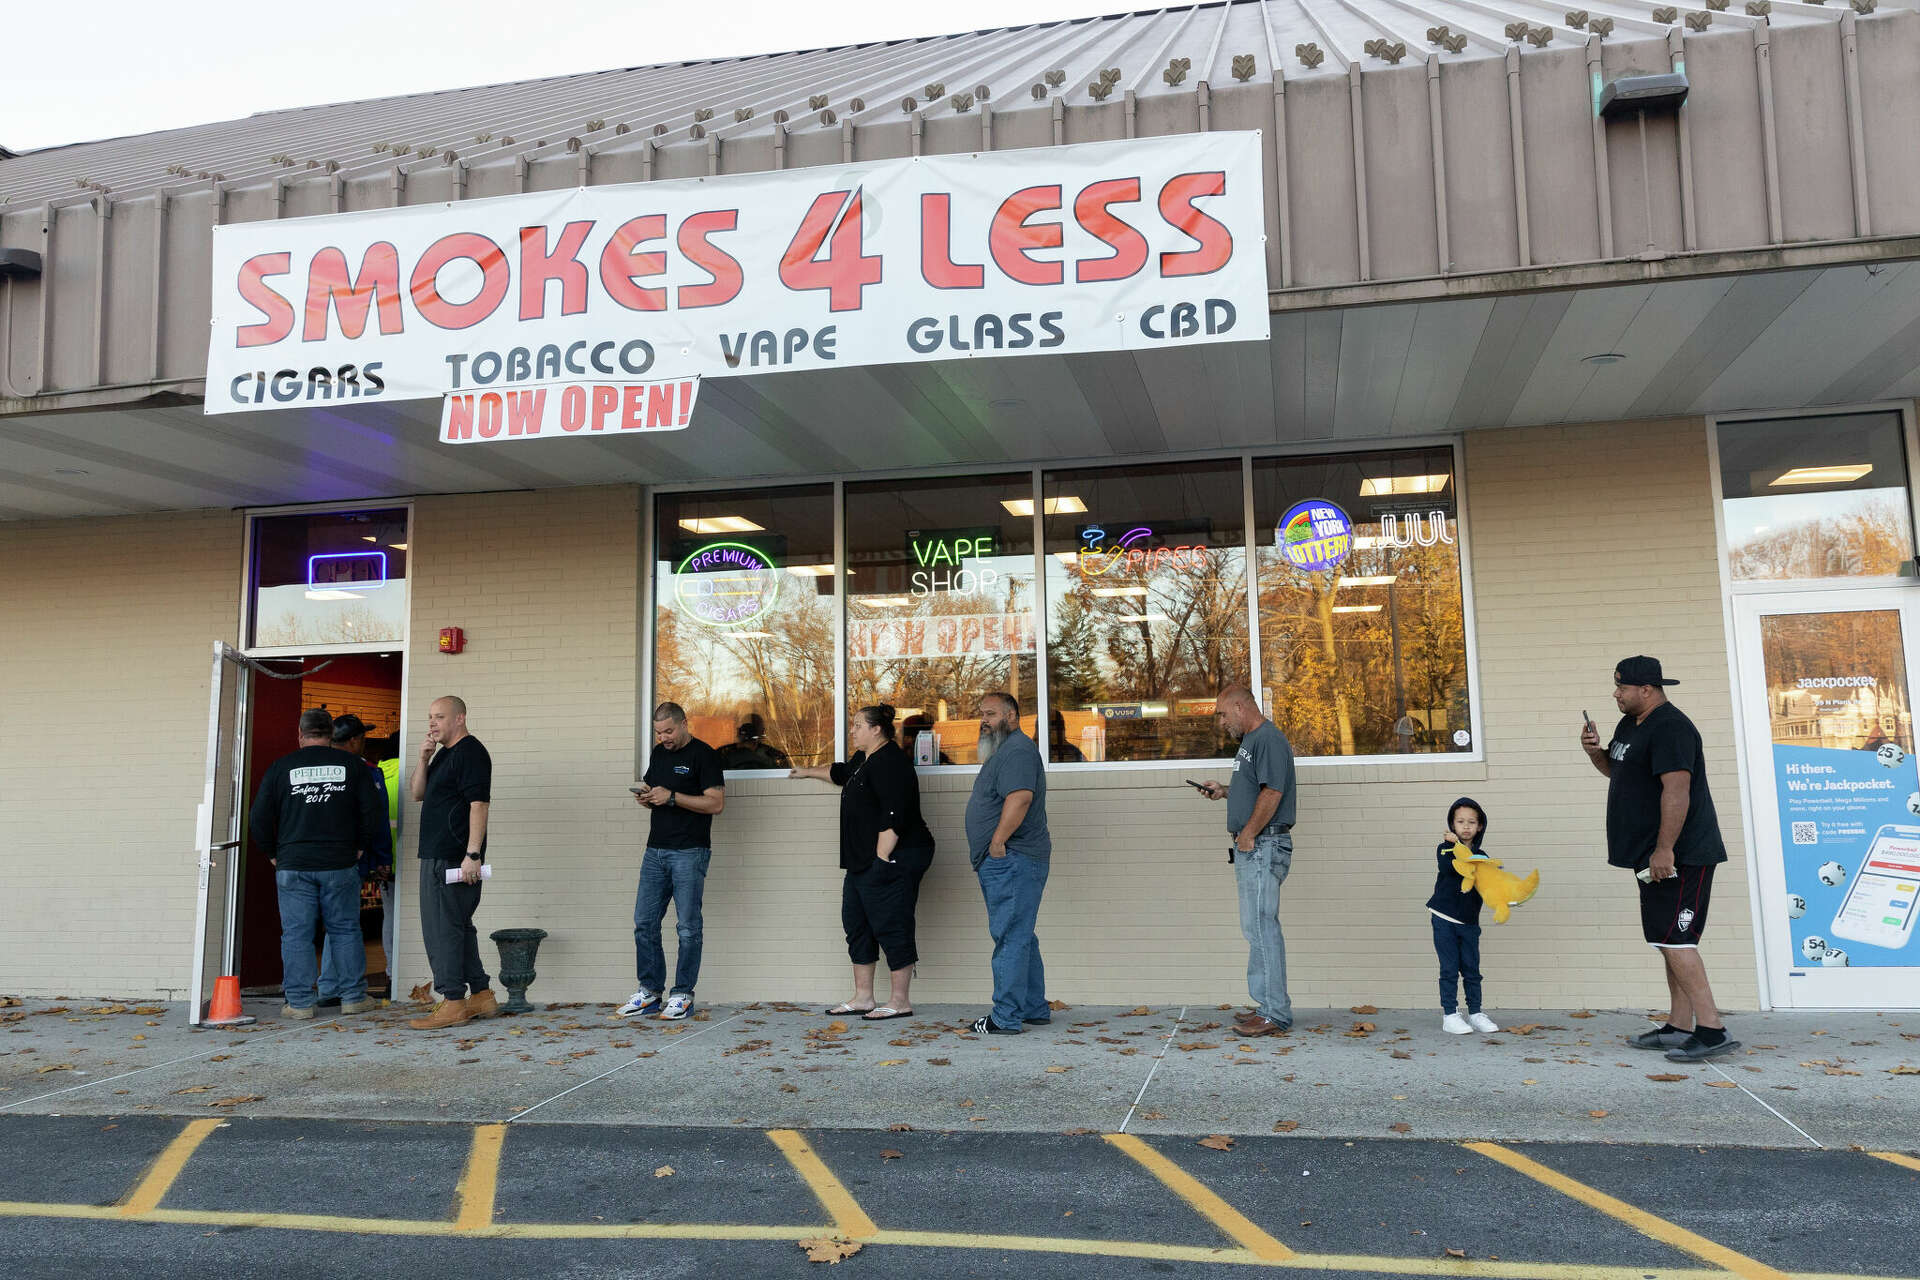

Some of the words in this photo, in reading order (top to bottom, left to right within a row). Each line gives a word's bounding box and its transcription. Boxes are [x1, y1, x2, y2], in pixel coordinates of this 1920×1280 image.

[236, 208, 745, 348] SMOKES
[778, 184, 883, 313] 4
[920, 170, 1234, 290] LESS
[230, 360, 386, 404] CIGARS
[445, 338, 656, 389] TOBACCO
[719, 324, 837, 369] VAPE
[906, 310, 1066, 354] GLASS
[1139, 298, 1237, 339] CBD
[447, 389, 548, 440] NOW
[559, 380, 692, 432] OPEN!
[1310, 507, 1336, 520] NEW
[1314, 519, 1346, 538] YORK
[1379, 510, 1454, 548] JUUL
[912, 537, 993, 567] VAPE
[1126, 545, 1207, 573] PIPES
[1286, 533, 1349, 564] LOTTERY
[691, 548, 763, 573] PREMIUM
[911, 568, 998, 598] SHOP
[1878, 746, 1895, 758] 25
[294, 767, 342, 778] PETILLO
[1786, 763, 1800, 774] Hi
[1801, 763, 1837, 774] there.
[291, 785, 320, 796] Safety
[322, 783, 347, 793] First
[1787, 778, 1822, 791] We're
[1823, 778, 1896, 792] Jackpocket.
[305, 793, 331, 804] 2017
[1808, 939, 1826, 951] 54
